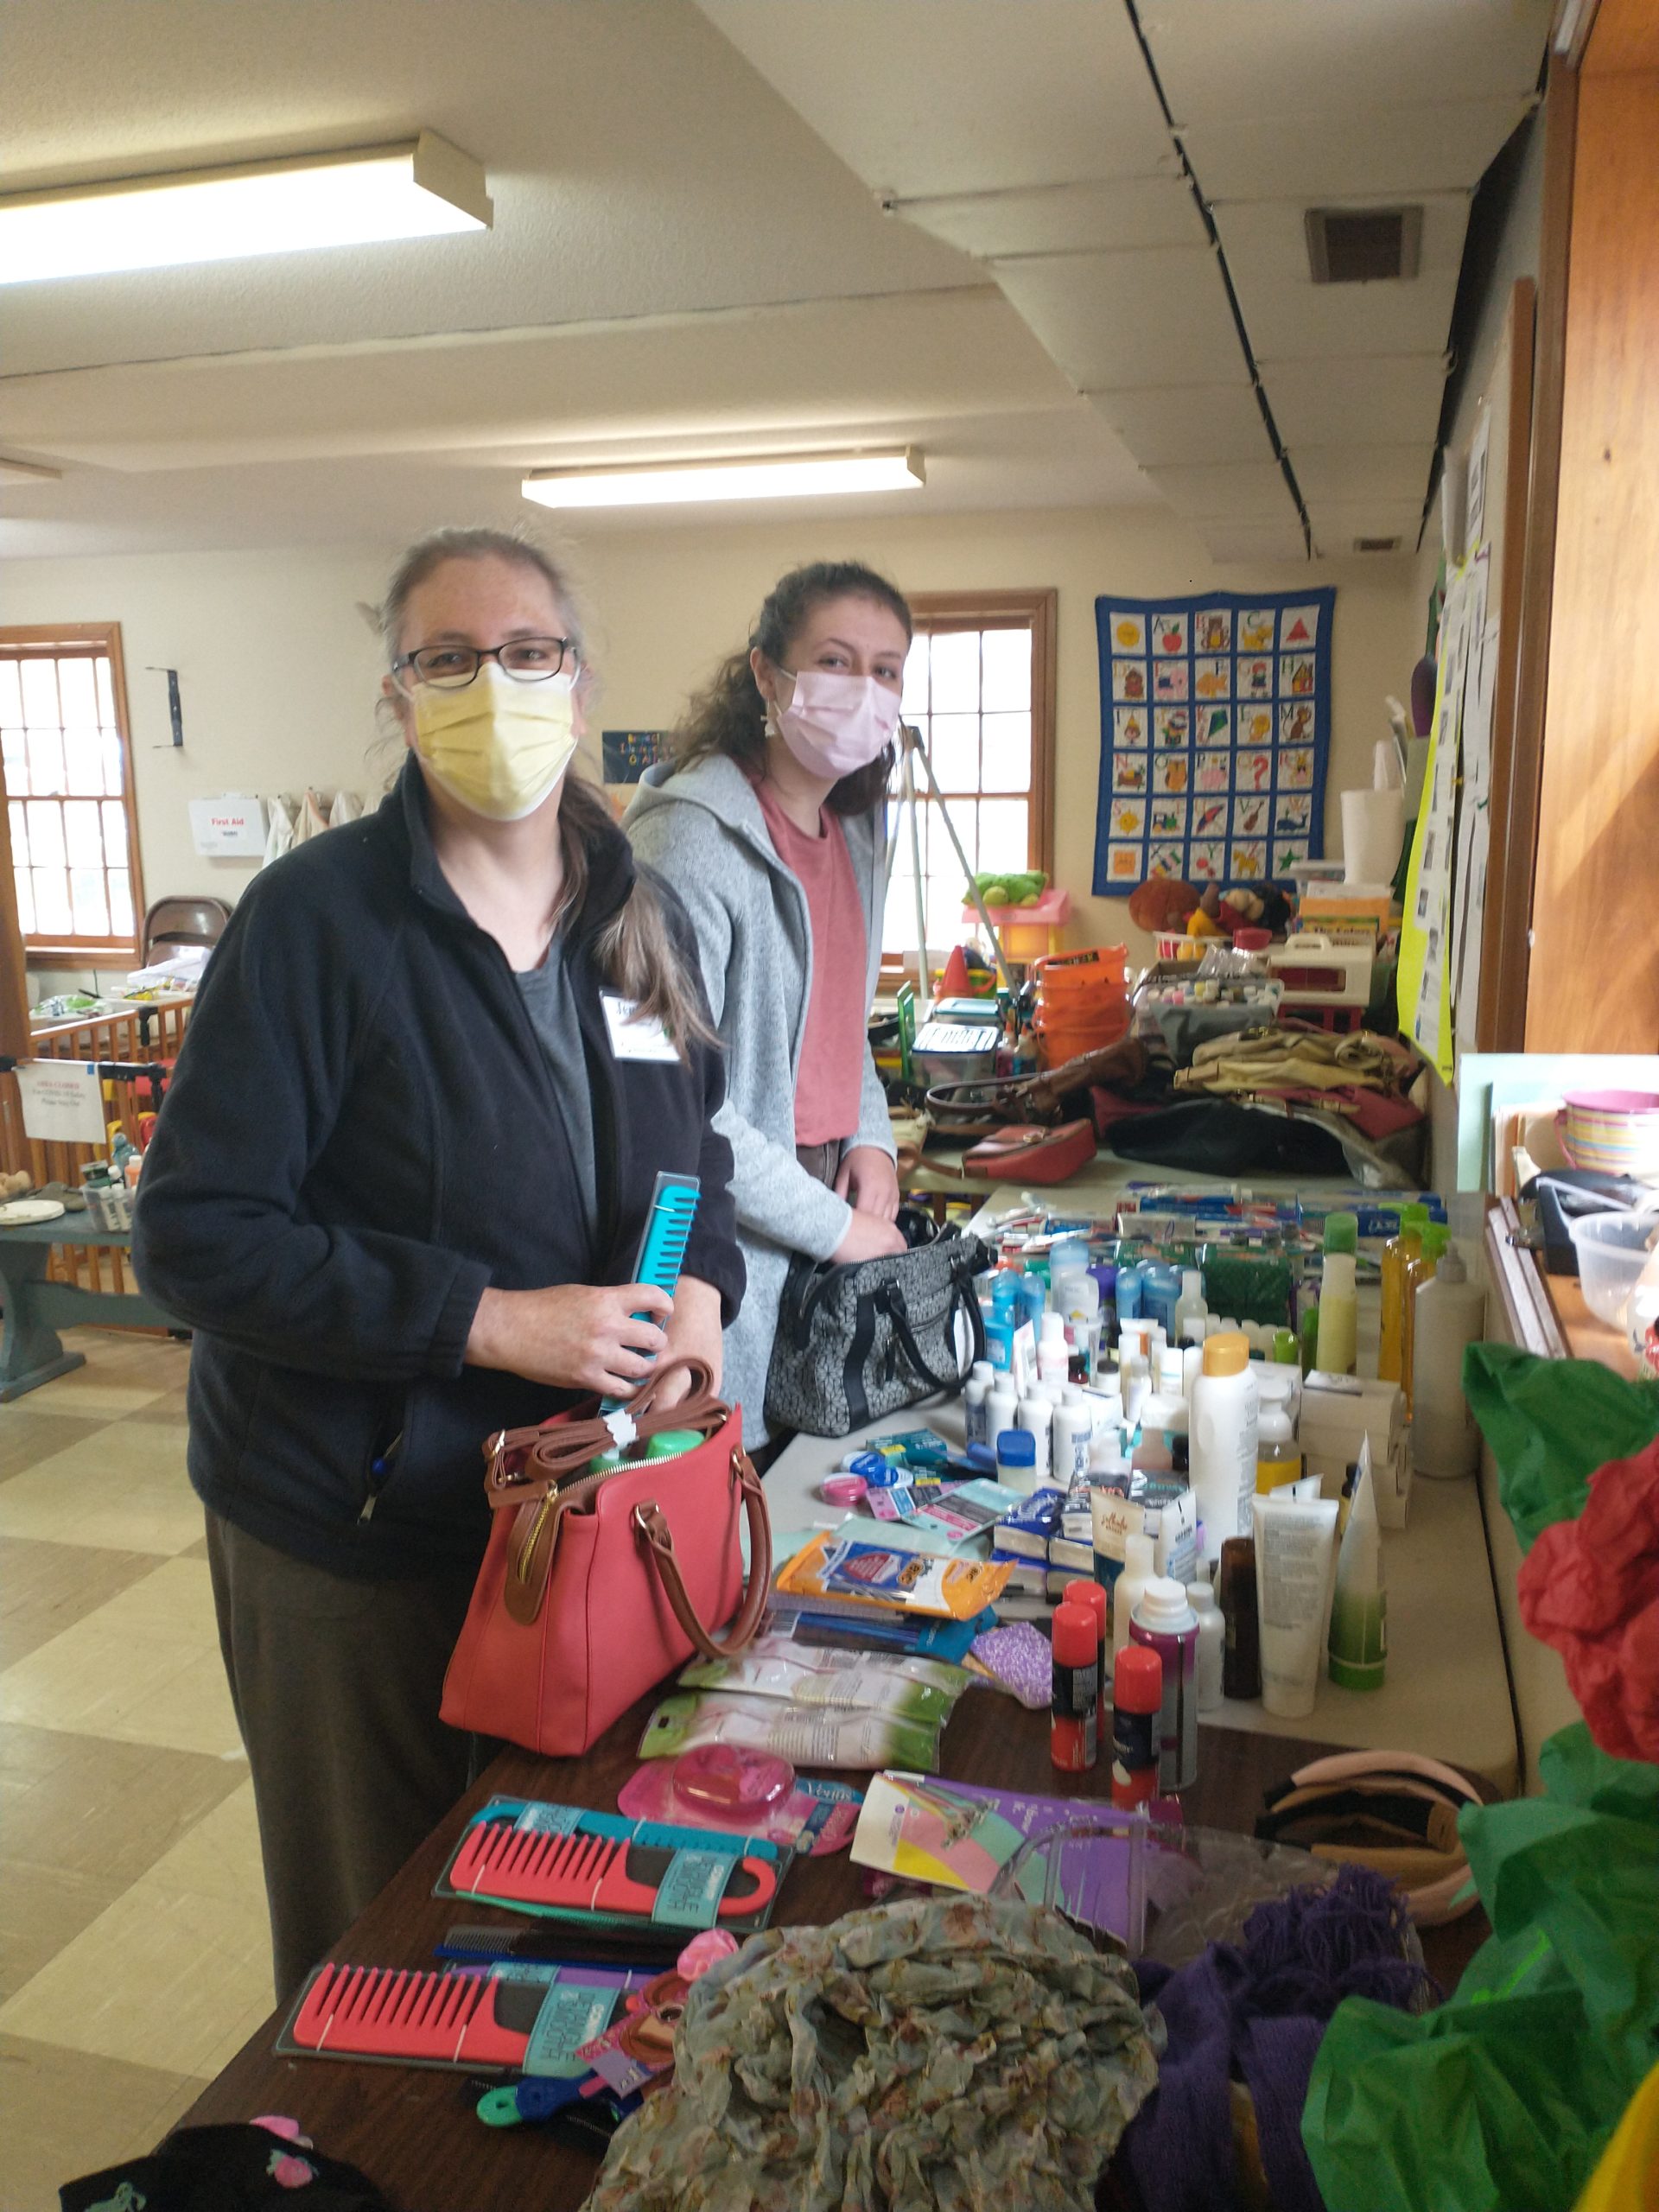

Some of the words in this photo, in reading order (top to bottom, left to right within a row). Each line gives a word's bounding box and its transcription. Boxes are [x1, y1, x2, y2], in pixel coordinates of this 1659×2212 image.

[1154, 615, 1165, 634] A
[1215, 658, 1224, 675] F
[1281, 657, 1294, 674] H
[1281, 703, 1294, 721] M
[1116, 753, 1128, 770] N
[1197, 751, 1206, 768] P
[1239, 798, 1250, 814] V
